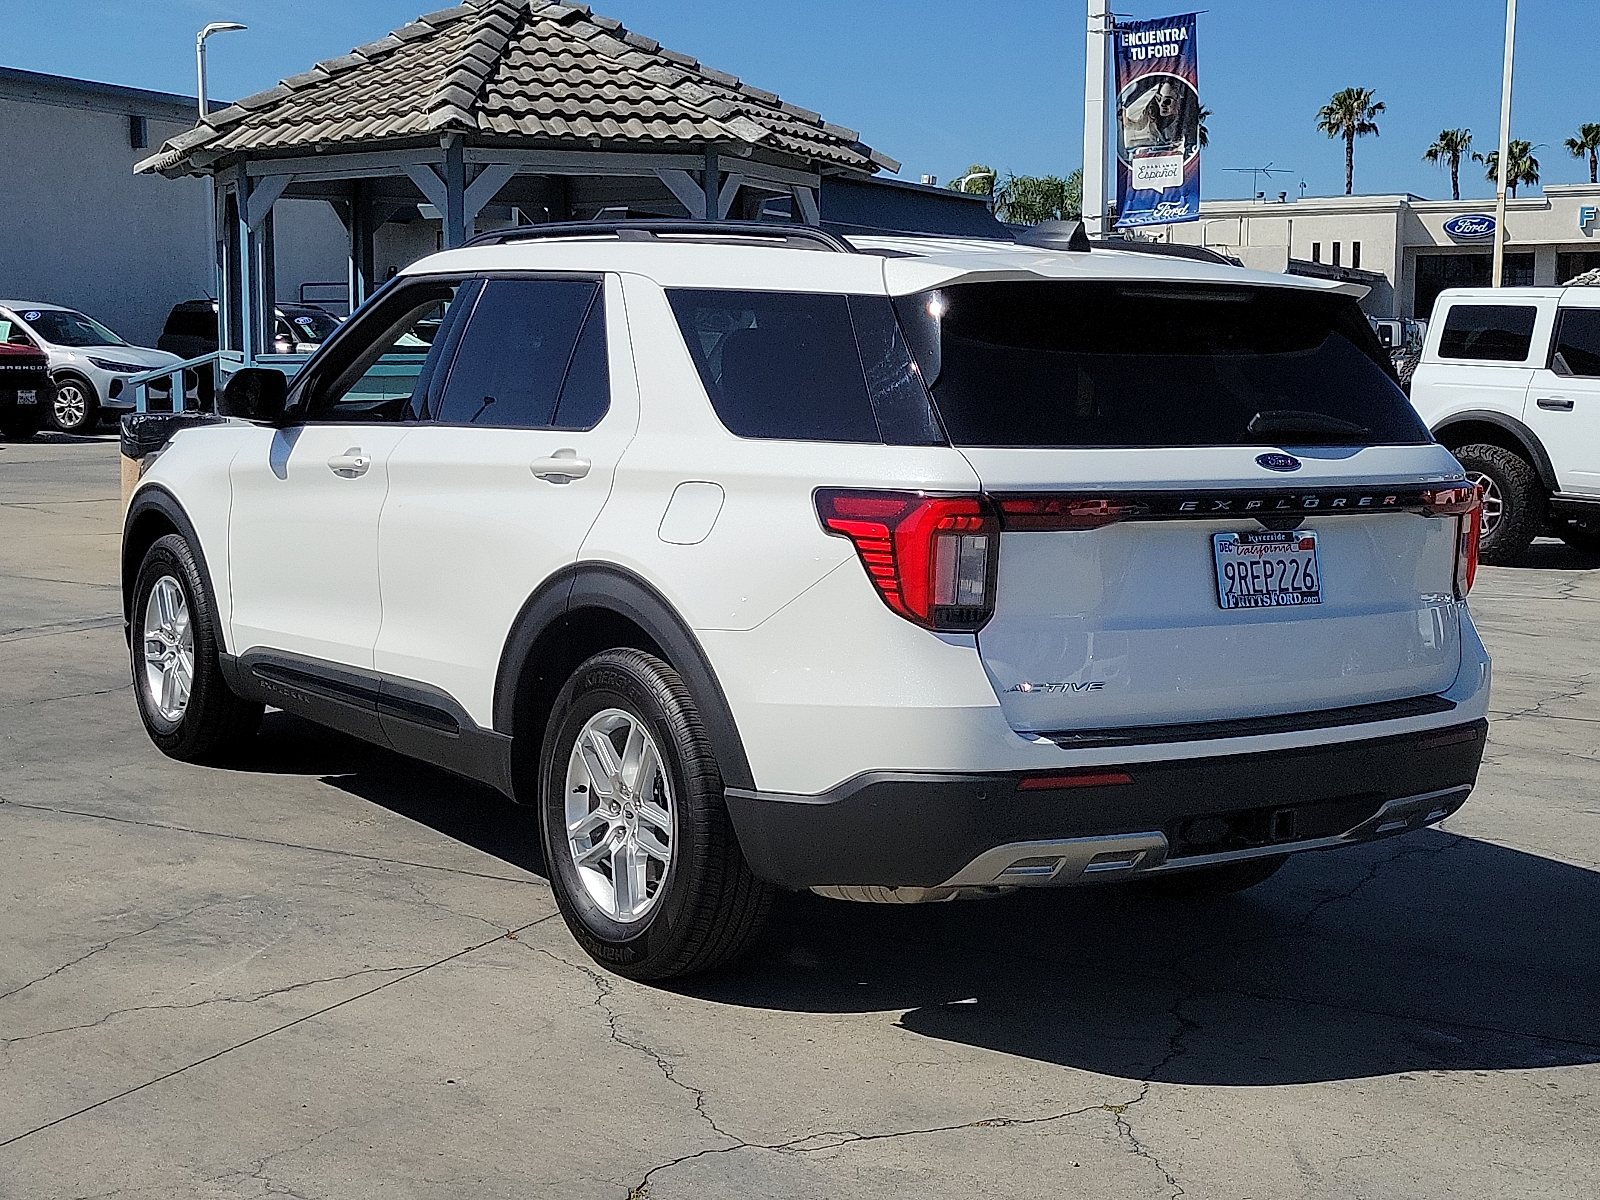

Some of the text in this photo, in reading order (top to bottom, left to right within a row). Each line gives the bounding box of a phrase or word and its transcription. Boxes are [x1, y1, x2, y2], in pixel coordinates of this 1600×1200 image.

[1122, 27, 1188, 46] ENCUENTRA
[1131, 44, 1179, 60] TU FORD
[1138, 166, 1178, 180] Español
[1153, 202, 1189, 217] Ford
[1579, 205, 1595, 227] F
[1455, 218, 1489, 232] Ford
[1179, 495, 1397, 512] EXPLORER
[1247, 533, 1286, 543] Riverside
[1220, 541, 1232, 552] DEC
[1236, 543, 1299, 559] California
[1224, 557, 1315, 595] 9REP226
[1003, 681, 1106, 693] ACTIVE
